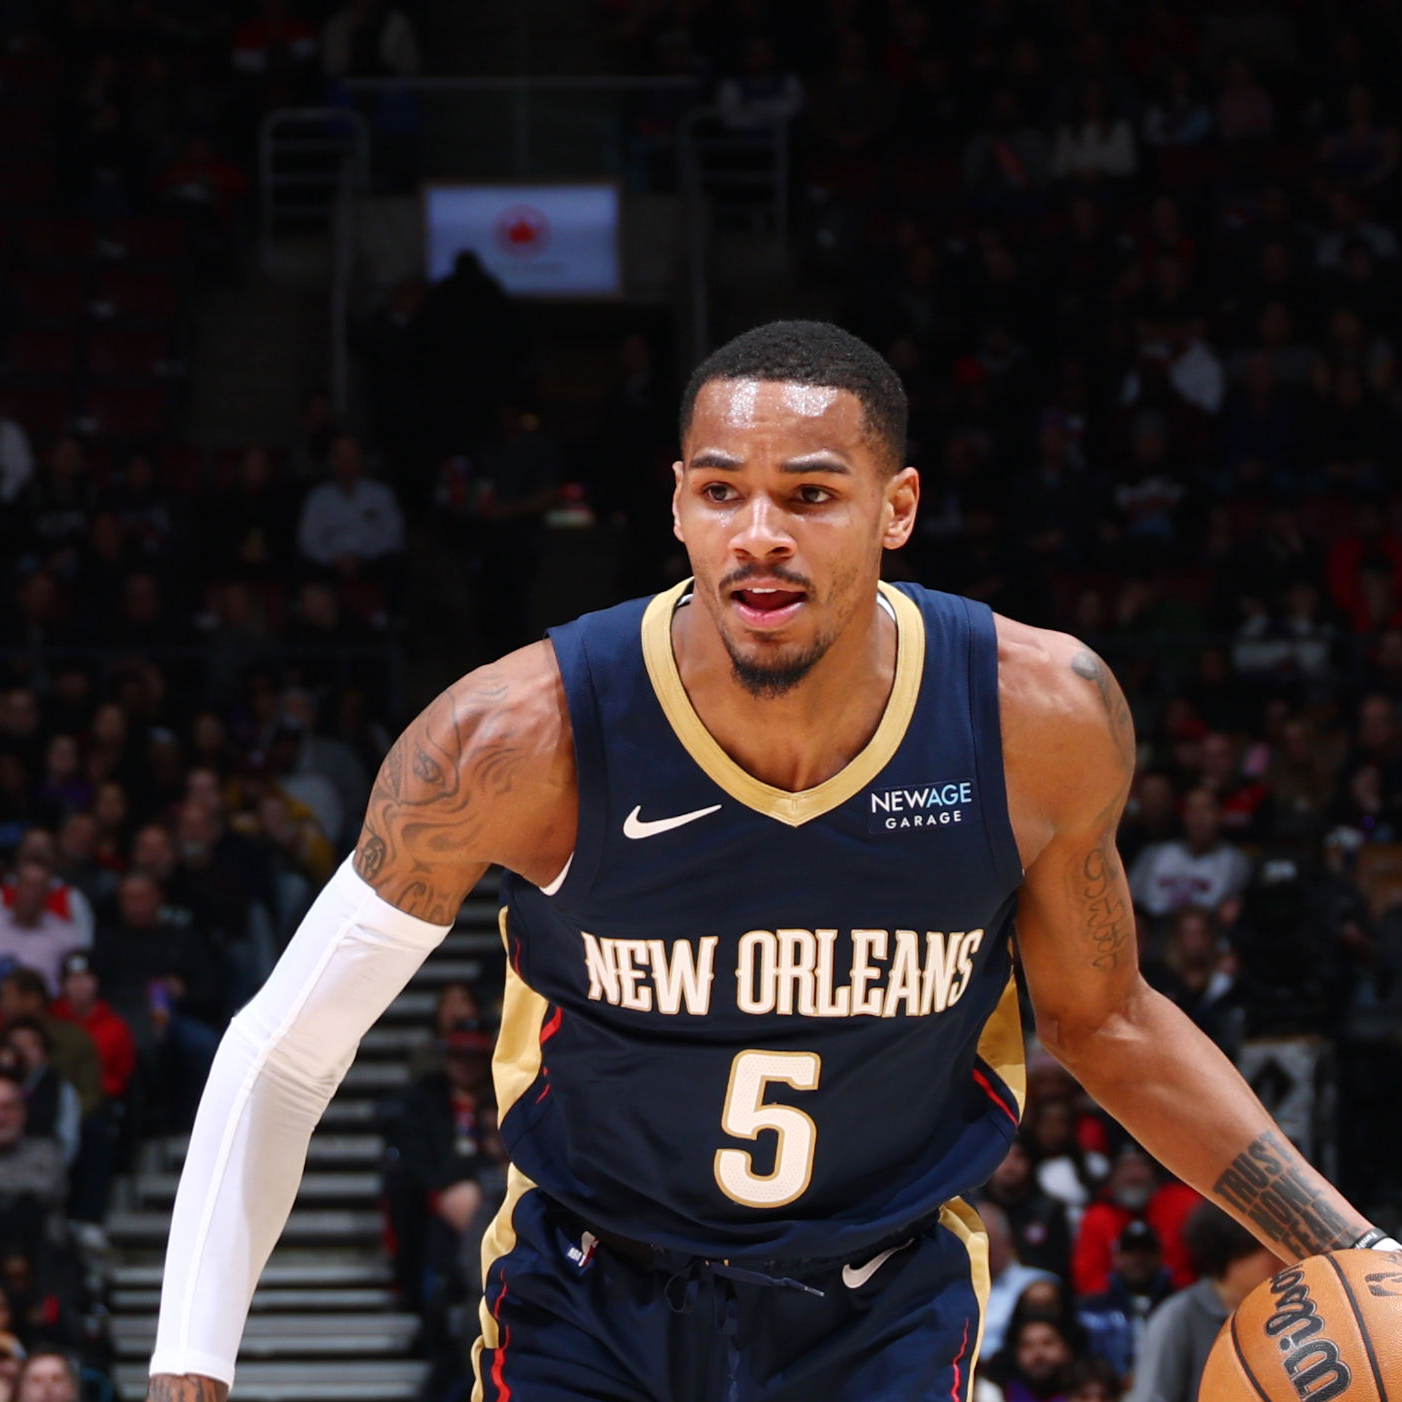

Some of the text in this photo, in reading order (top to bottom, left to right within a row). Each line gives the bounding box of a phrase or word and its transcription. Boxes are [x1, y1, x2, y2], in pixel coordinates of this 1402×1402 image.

[871, 783, 972, 813] NEWAGE
[885, 810, 962, 829] GARAGE
[581, 928, 983, 1018] NEW ORLEANS
[714, 1049, 821, 1208] 5
[1212, 1131, 1293, 1215] TRUST
